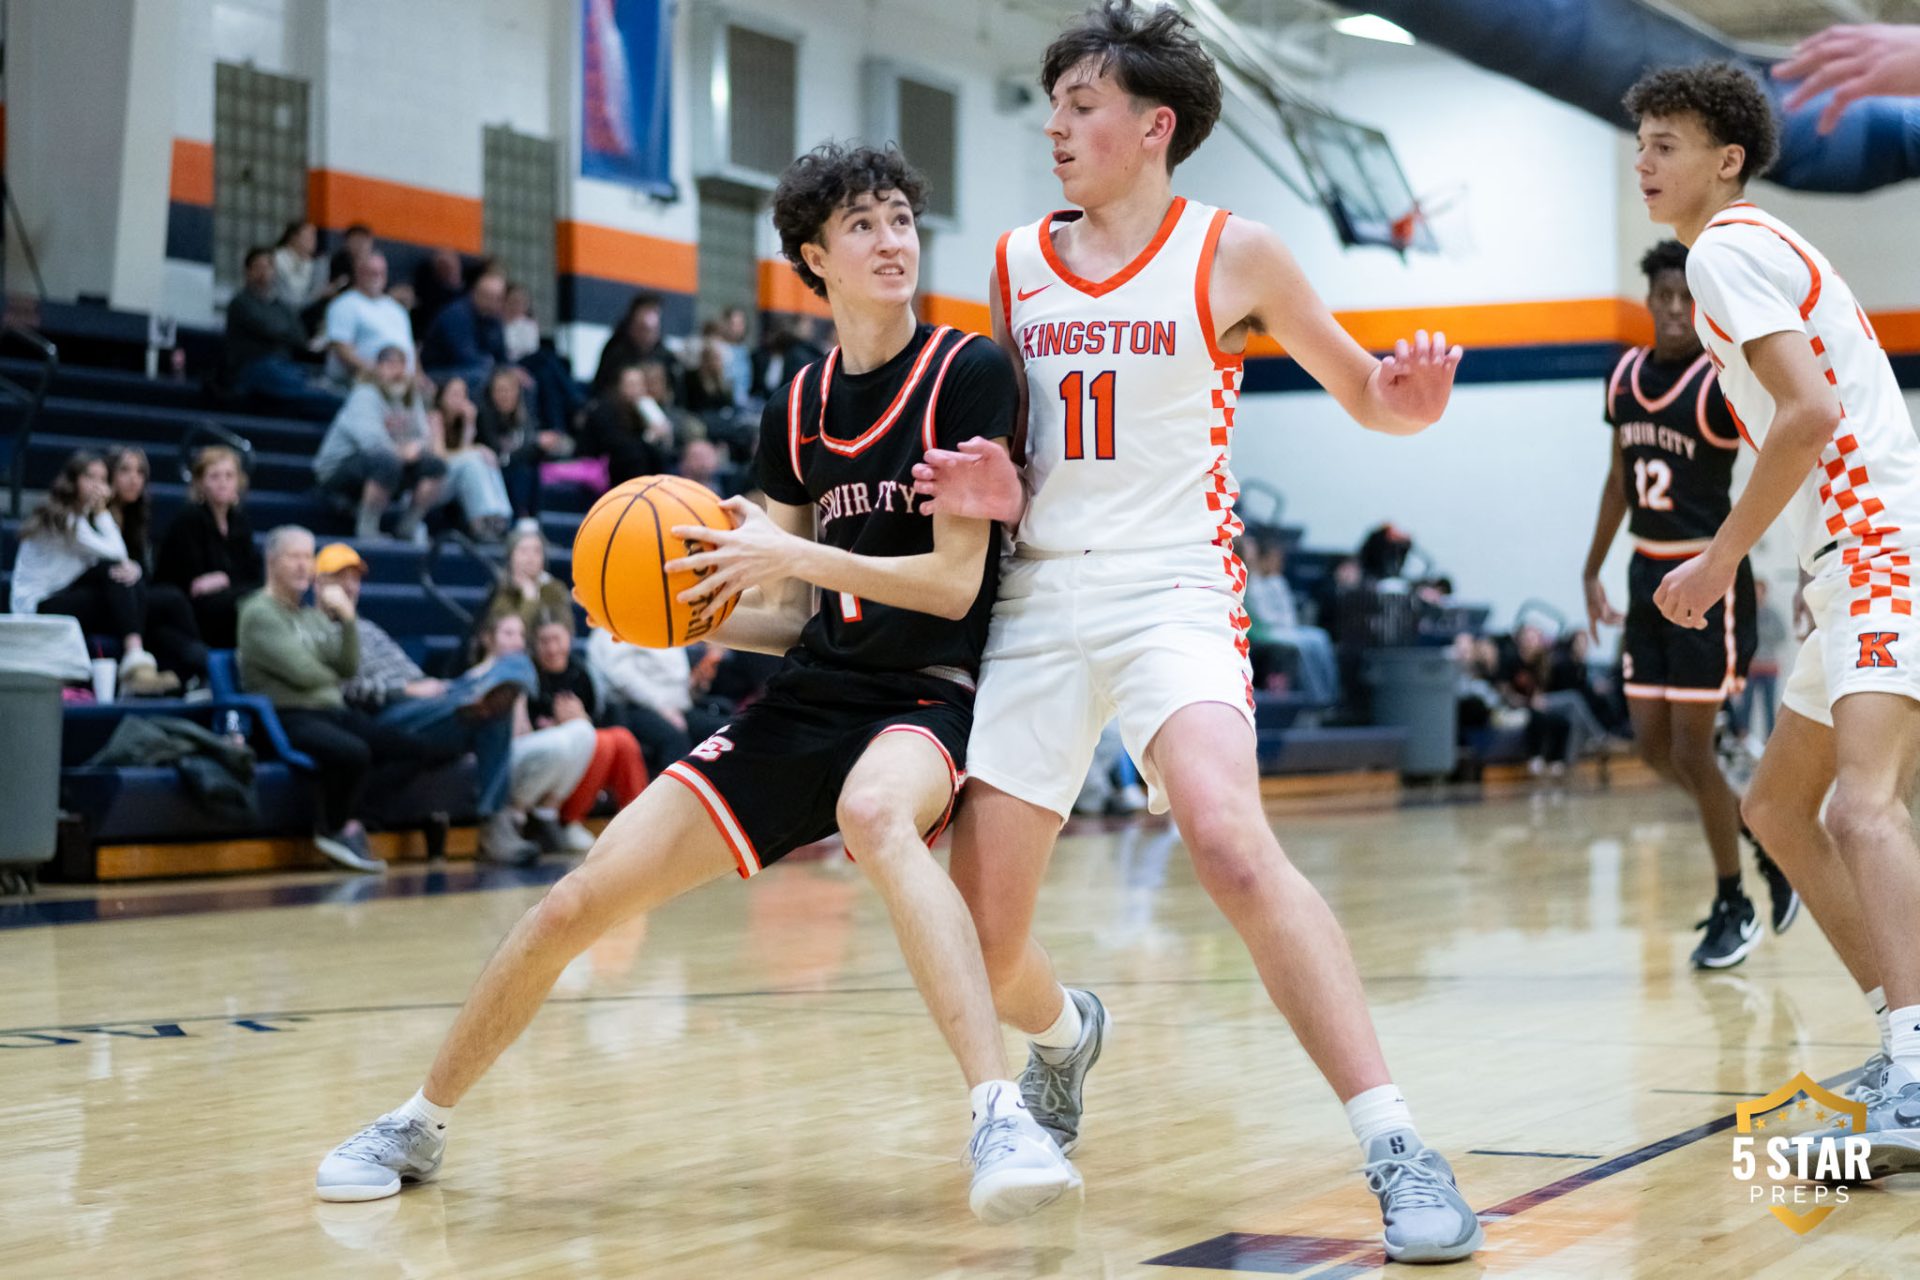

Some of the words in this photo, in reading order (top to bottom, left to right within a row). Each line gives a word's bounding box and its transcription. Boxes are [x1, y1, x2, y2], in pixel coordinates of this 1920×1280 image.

[1023, 321, 1176, 360] KINGSTON
[1059, 370, 1116, 460] 11
[1658, 425, 1696, 459] CITY
[1634, 457, 1673, 511] 12
[1856, 632, 1899, 668] K
